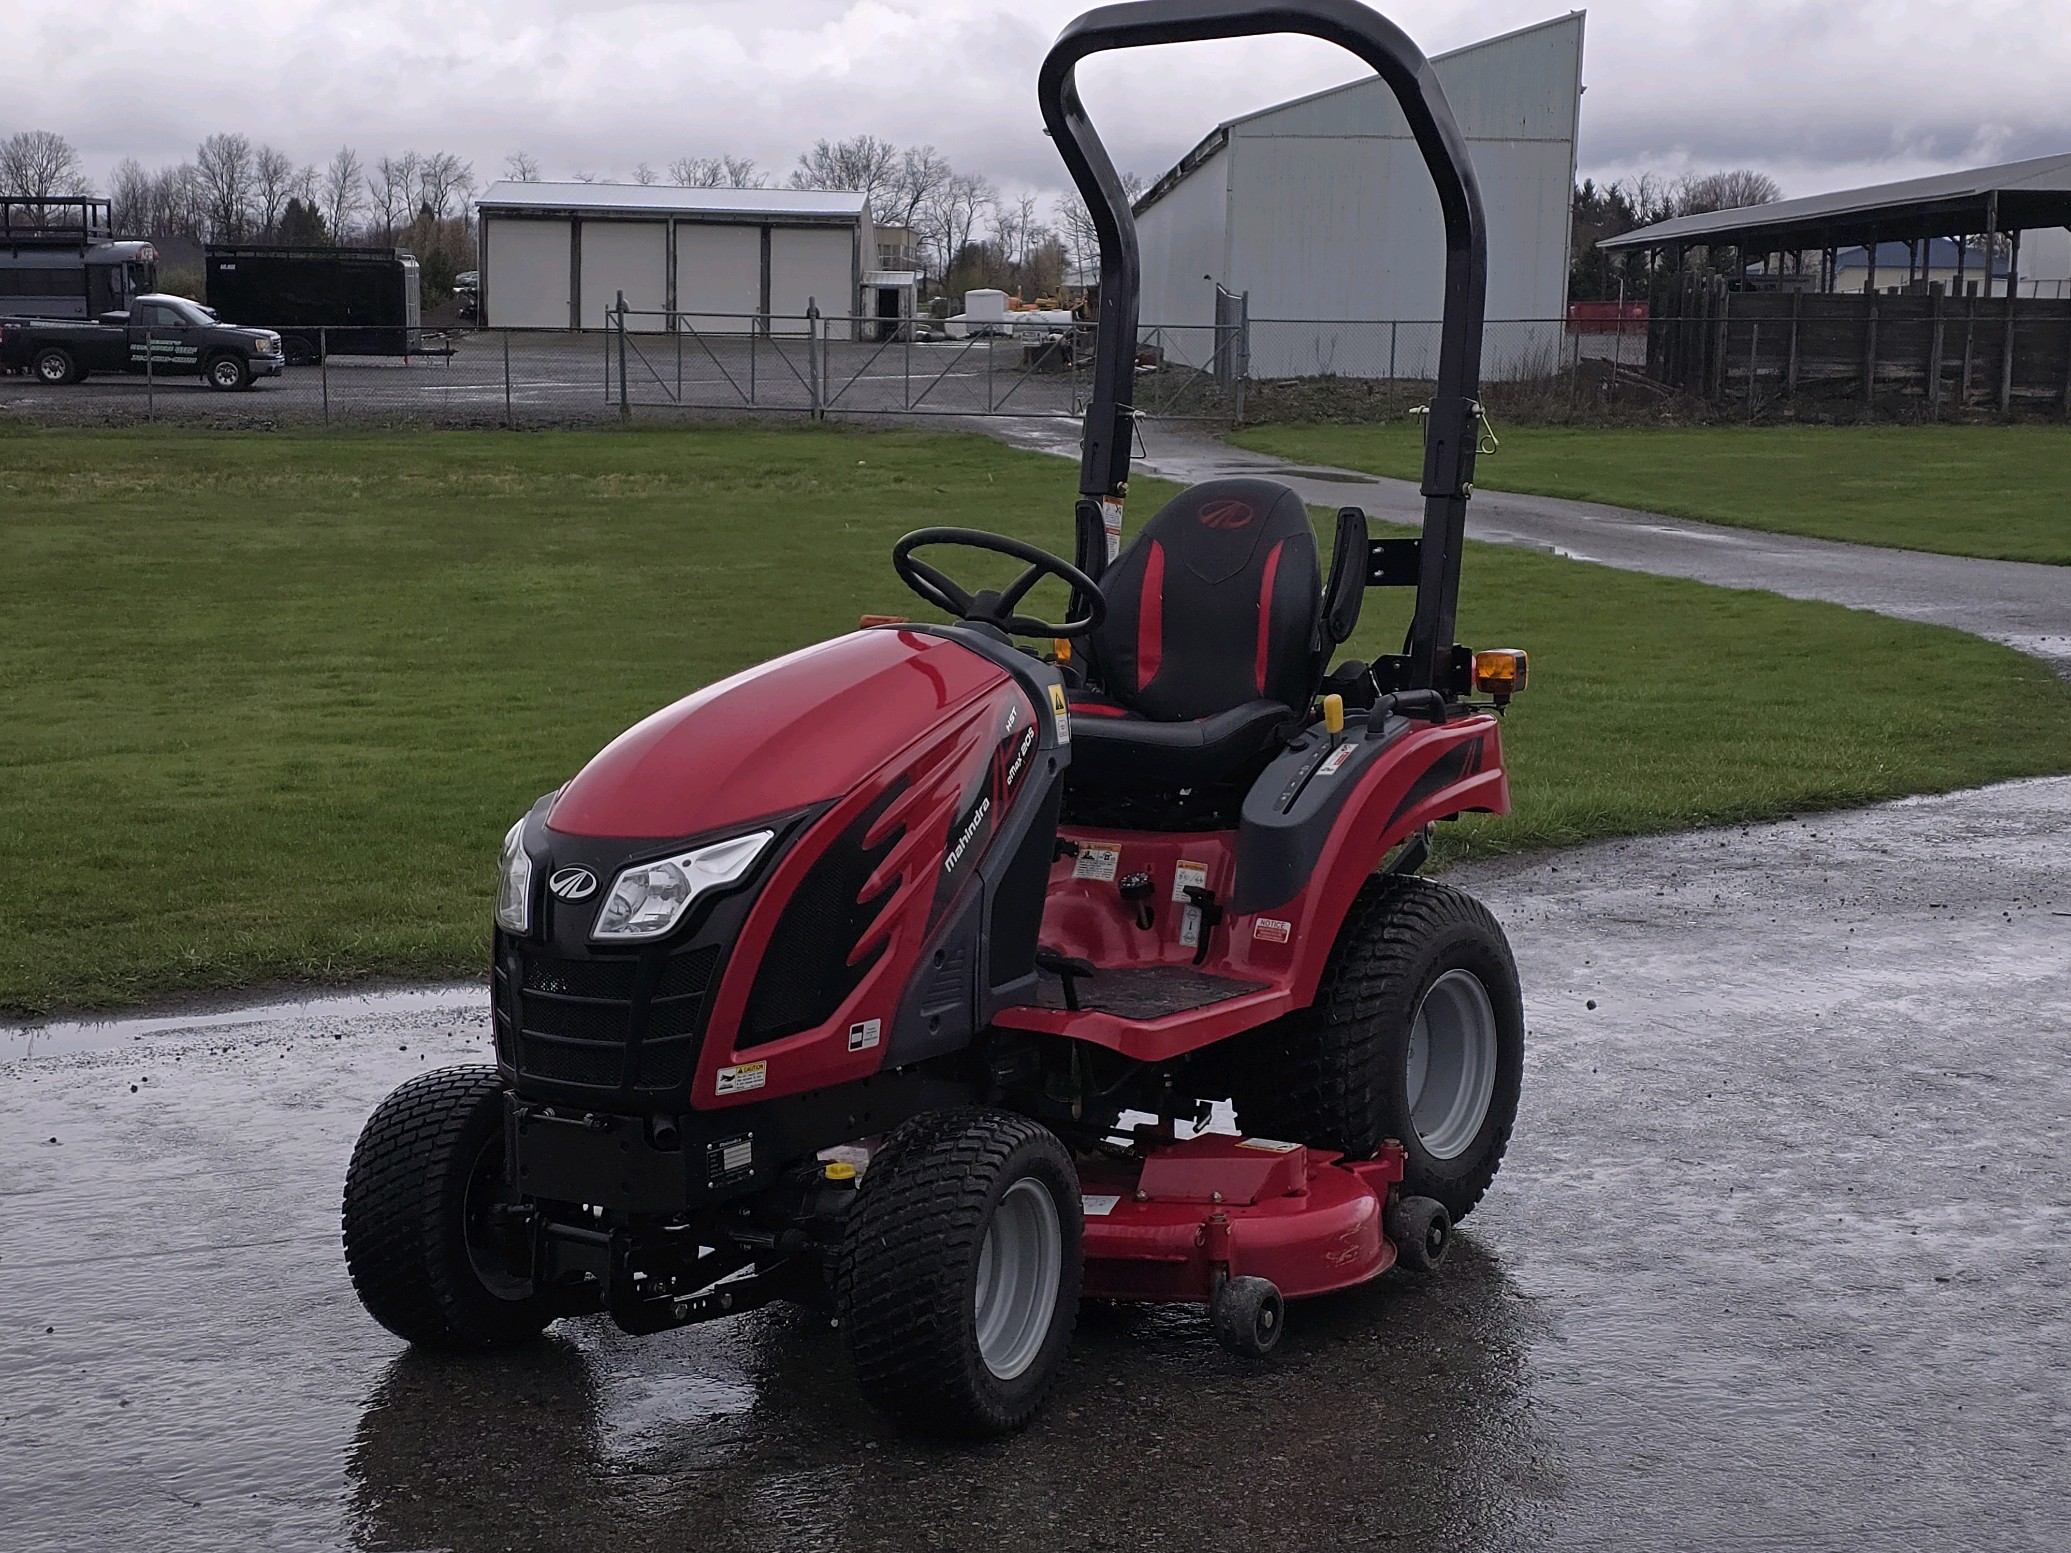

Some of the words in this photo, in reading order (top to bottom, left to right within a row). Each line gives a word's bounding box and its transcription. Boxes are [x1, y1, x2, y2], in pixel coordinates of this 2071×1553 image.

[1005, 705, 1018, 733] HST
[944, 797, 990, 873] Mahindra
[1260, 919, 1286, 929] NOTICE
[743, 1064, 764, 1073] CAUTION
